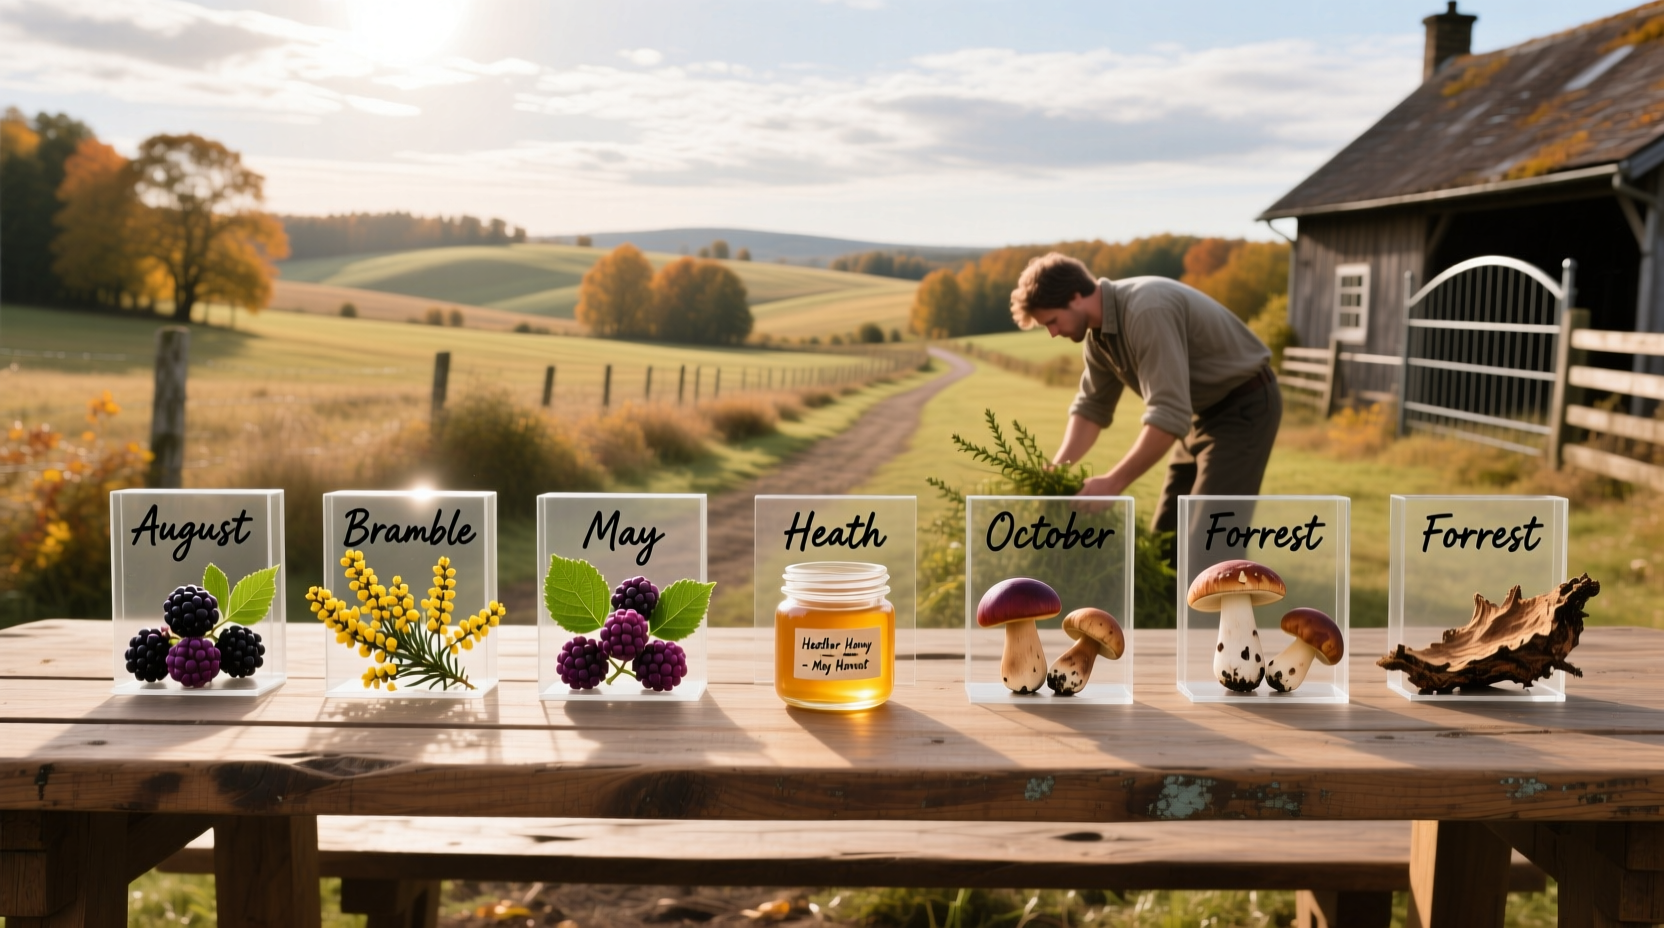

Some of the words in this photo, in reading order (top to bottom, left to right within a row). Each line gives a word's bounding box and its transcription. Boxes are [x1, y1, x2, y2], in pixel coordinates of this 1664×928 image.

[132, 504, 253, 561] August
[344, 508, 477, 548] Bramble
[583, 511, 666, 566] May
[784, 511, 887, 552] Heath
[987, 511, 1116, 552] October
[1206, 512, 1326, 552] Forrest
[1423, 514, 1544, 553] Forrest
